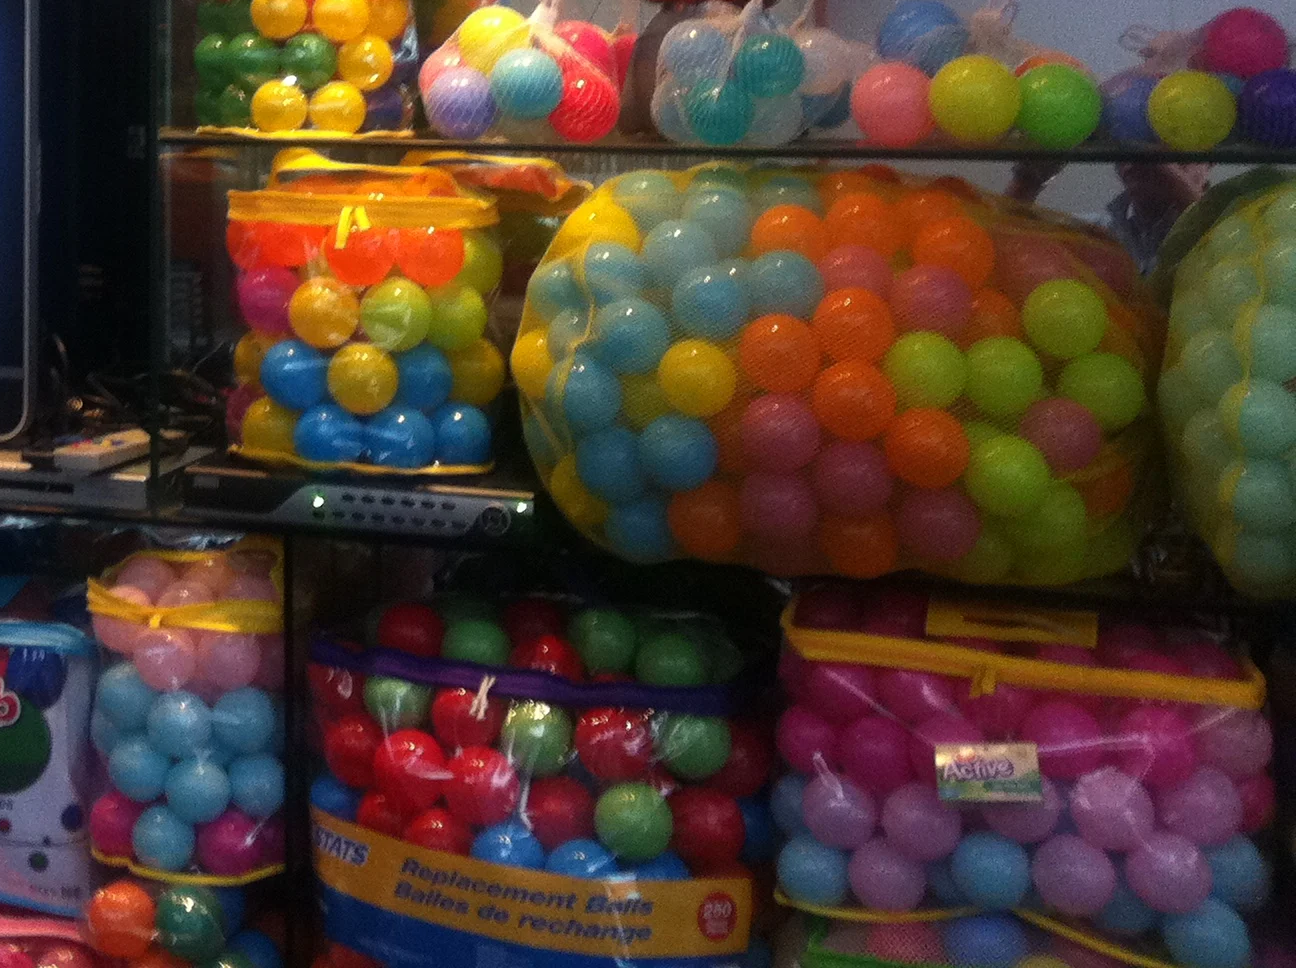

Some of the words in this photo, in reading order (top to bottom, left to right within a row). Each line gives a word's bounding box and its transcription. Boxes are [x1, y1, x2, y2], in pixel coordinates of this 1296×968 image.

[943, 757, 1015, 782] Active
[394, 881, 470, 915] Balles
[477, 904, 510, 923] de
[518, 913, 653, 946] rechange
[401, 858, 578, 911] Replacement
[585, 894, 653, 915] Balls
